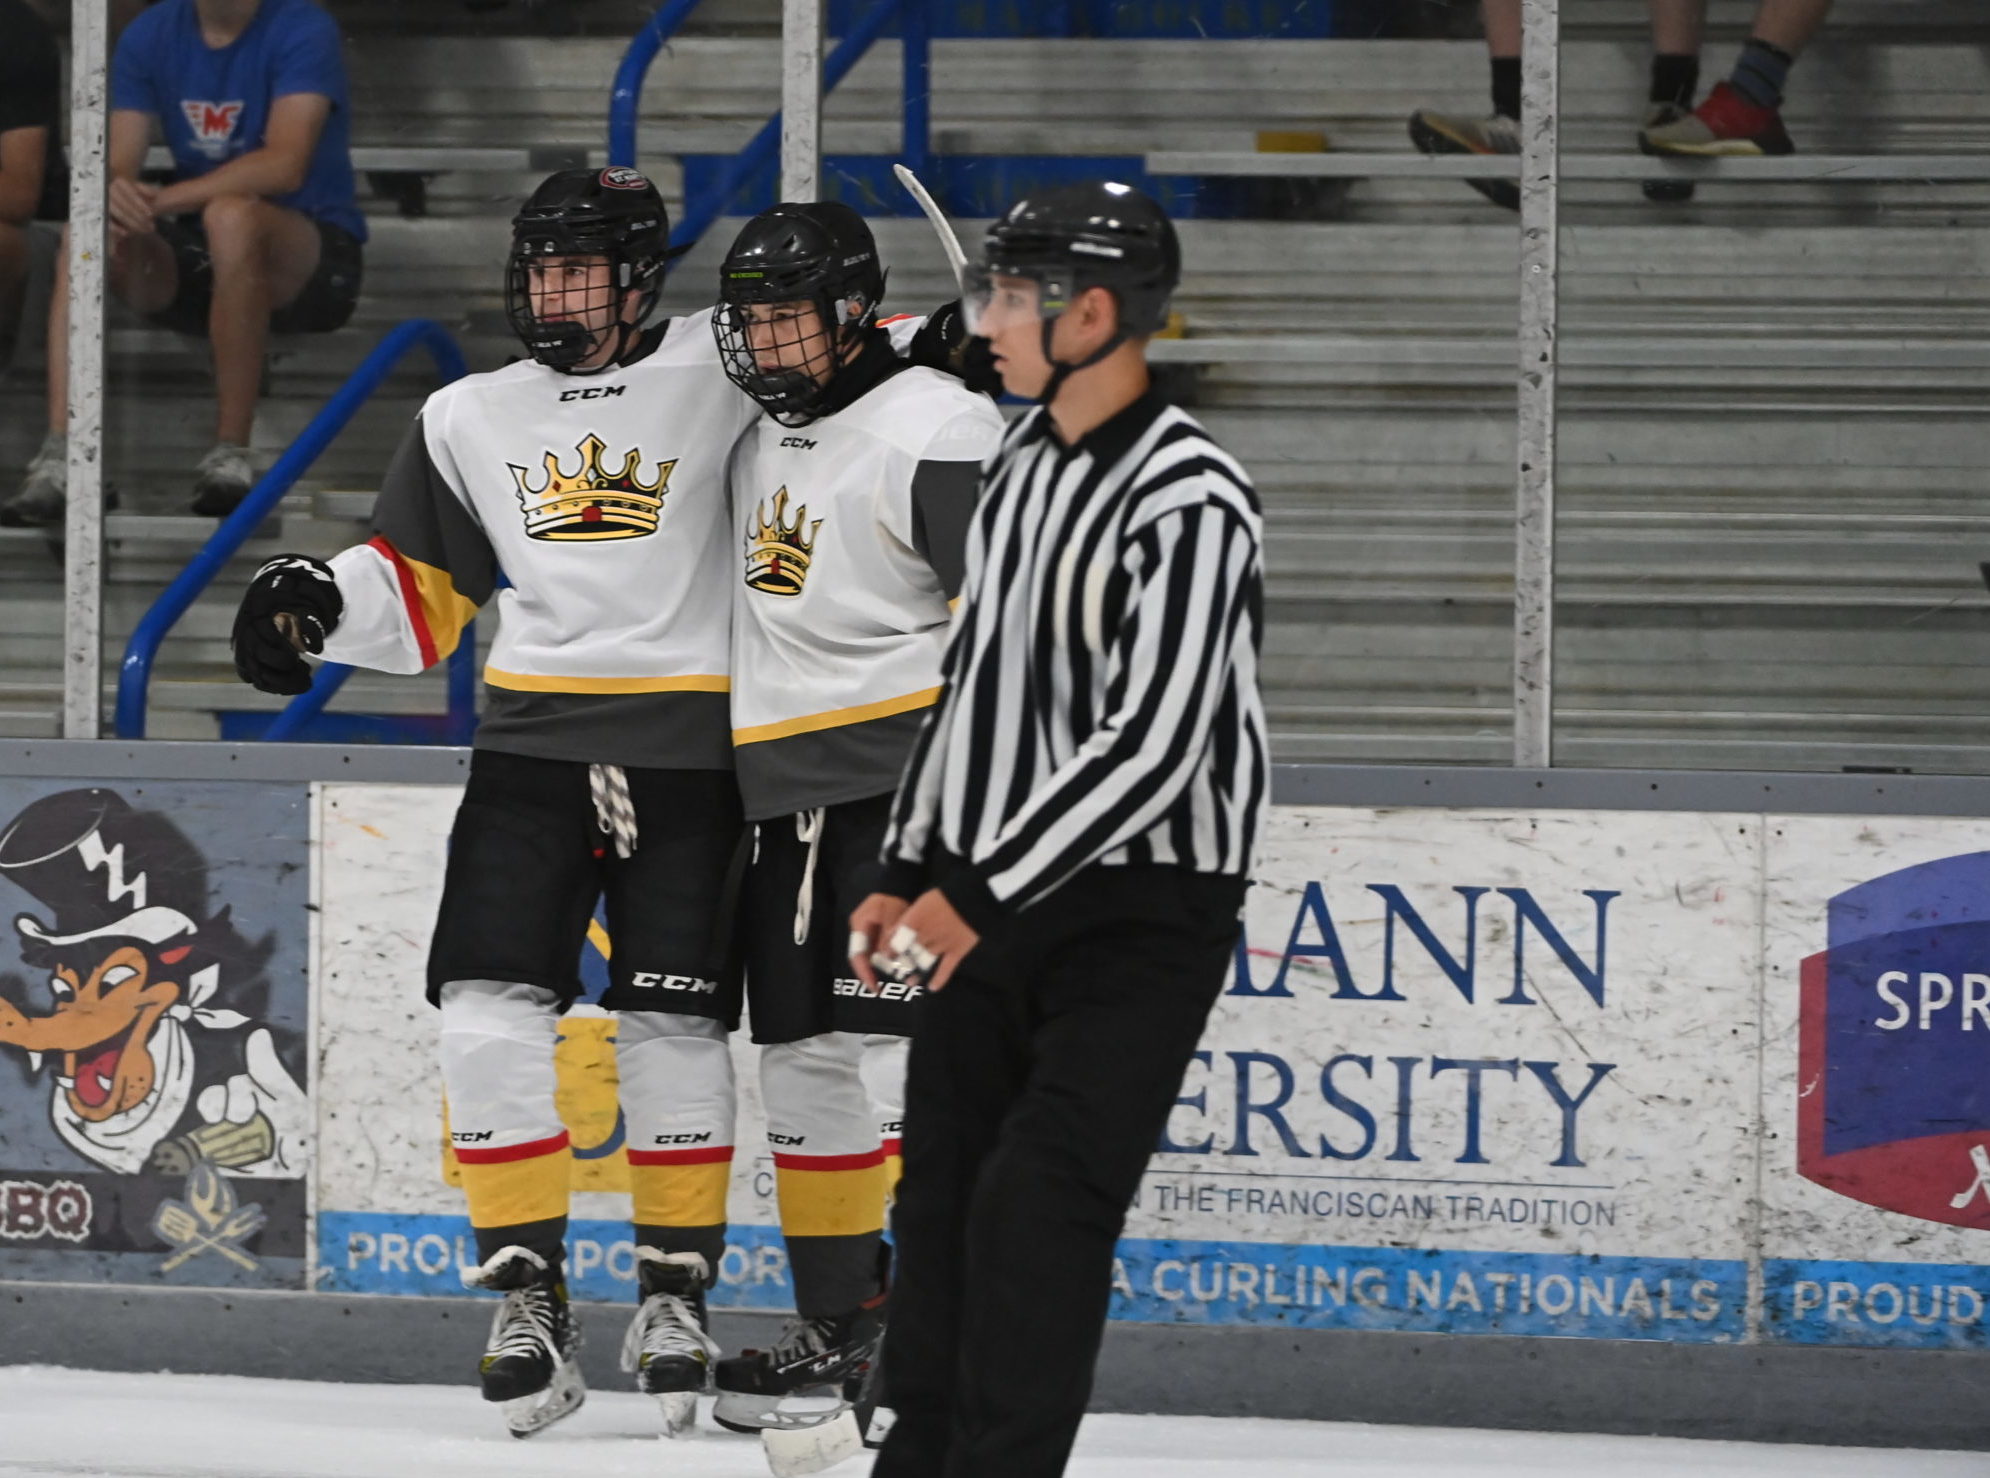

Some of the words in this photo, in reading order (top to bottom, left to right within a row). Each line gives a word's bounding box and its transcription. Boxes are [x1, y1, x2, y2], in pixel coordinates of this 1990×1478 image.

[559, 385, 626, 402] CCM
[780, 437, 818, 450] CCM
[632, 971, 718, 994] CCM
[655, 1131, 712, 1145] CCM
[0, 1179, 93, 1242] BQ
[1154, 1185, 1214, 1212] THE
[1227, 1188, 1432, 1220] FRANCISCAN
[1446, 1195, 1615, 1227] TRADITION
[1152, 1259, 1388, 1307] CURLING
[1407, 1270, 1721, 1322] NATIONALS
[1794, 1279, 1985, 1327] PROUD
